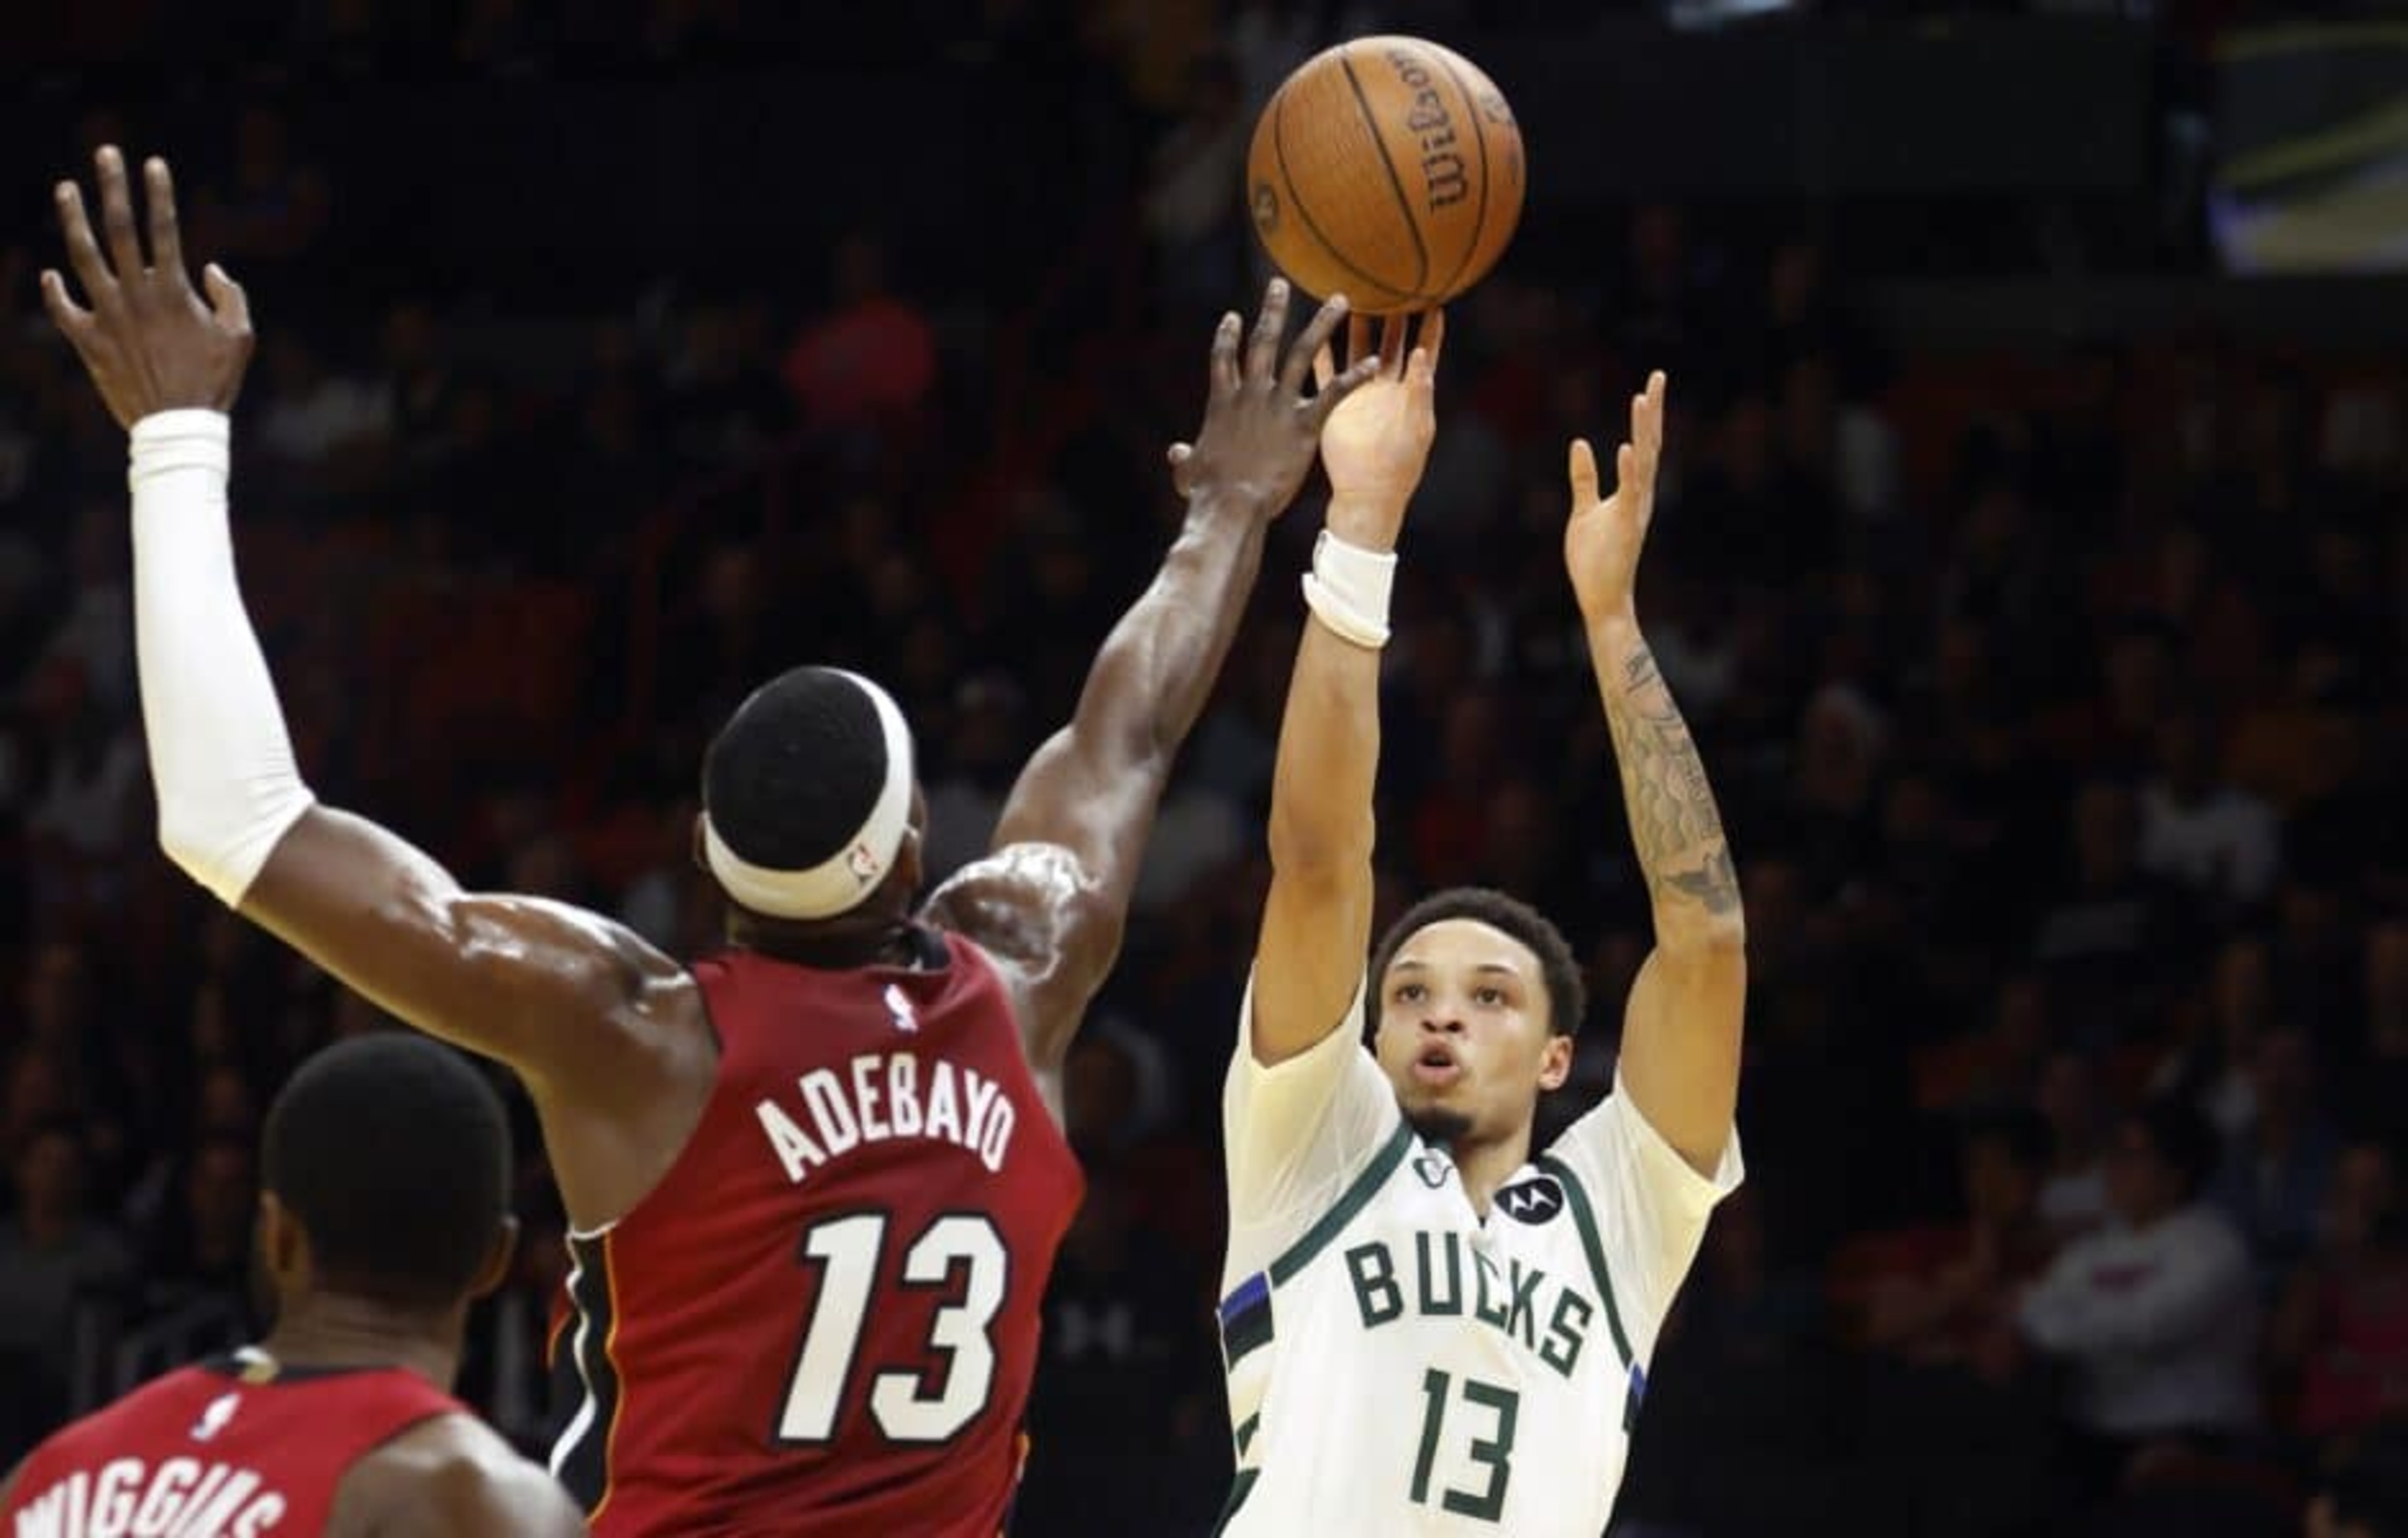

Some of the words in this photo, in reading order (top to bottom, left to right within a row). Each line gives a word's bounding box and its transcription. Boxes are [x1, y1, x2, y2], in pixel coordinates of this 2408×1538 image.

[756, 1052, 1015, 1184] ADEBAYO
[775, 1211, 1009, 1444] 13
[1344, 1230, 1594, 1378] BUCKS
[1409, 1368, 1520, 1523] 13
